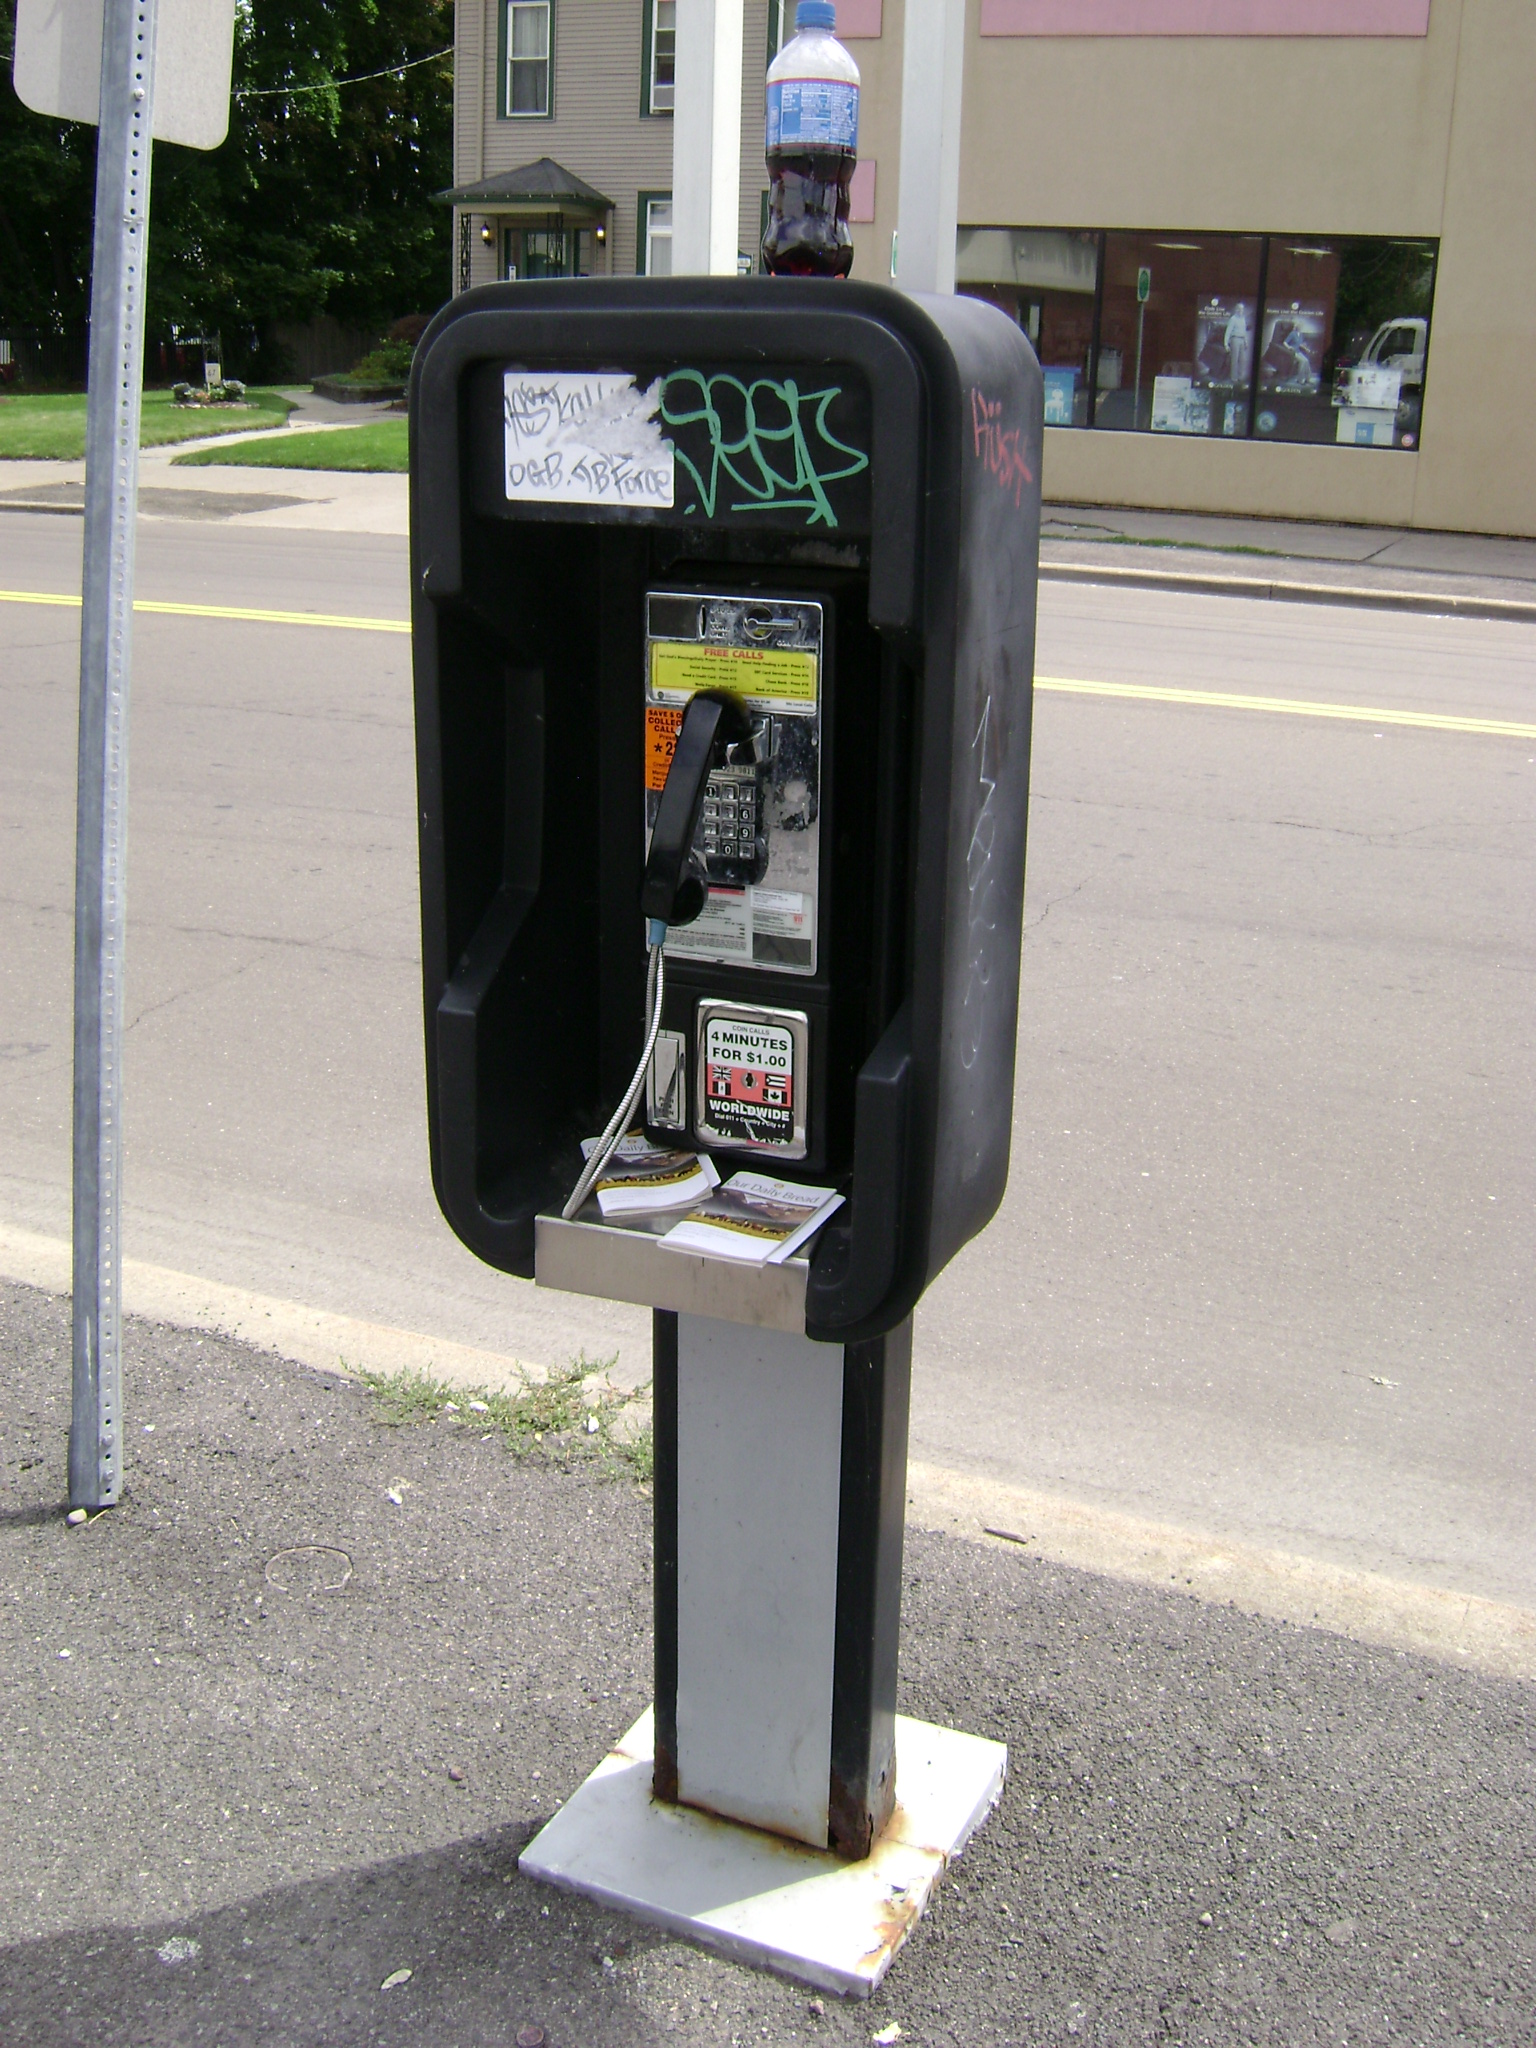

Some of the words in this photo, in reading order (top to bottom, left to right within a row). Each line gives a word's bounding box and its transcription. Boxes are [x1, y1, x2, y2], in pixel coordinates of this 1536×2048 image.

[704, 648, 729, 657] FREE
[732, 649, 763, 659] CALLS
[648, 717, 682, 726] COLLEC
[742, 810, 748, 819] 6
[742, 829, 748, 838] 9
[724, 846, 731, 854] 0
[732, 1025, 748, 1034] COIN
[749, 1026, 769, 1036] CALLS
[711, 1031, 719, 1040] 4
[722, 1032, 788, 1051] MINUTES
[712, 1047, 742, 1061] FOR
[746, 1052, 786, 1067] $1.00
[709, 1100, 790, 1122] WORLDWIDE
[727, 1180, 749, 1188] Our
[750, 1183, 781, 1197] Daily
[782, 1191, 820, 1203] Bread
